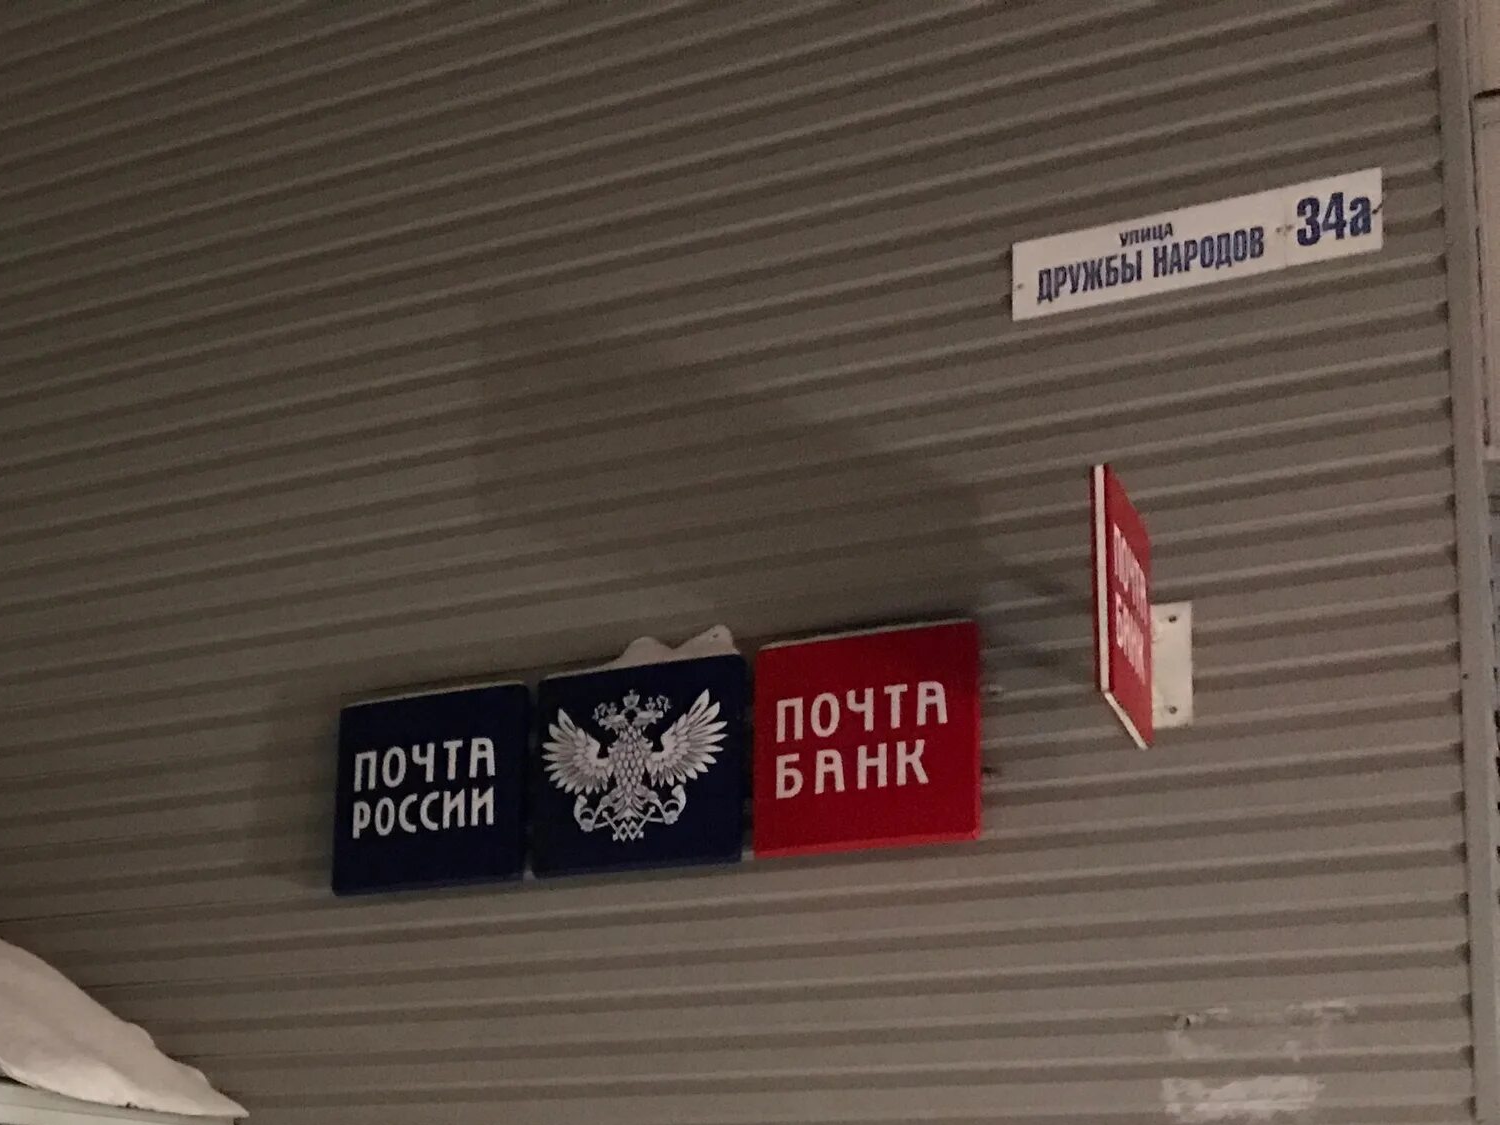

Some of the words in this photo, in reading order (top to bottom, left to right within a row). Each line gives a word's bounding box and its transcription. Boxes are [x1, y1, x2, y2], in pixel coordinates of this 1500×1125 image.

[1036, 251, 1142, 305] ДРУЖБЫ
[1152, 226, 1266, 278] НАРОДОВ
[1296, 192, 1373, 247] 34а
[1119, 222, 1174, 247] УЛИЦА
[775, 681, 949, 743] ПОЧТА
[353, 737, 496, 792] ПОЧТА
[775, 740, 929, 800] БАНК
[352, 787, 495, 839] РОССИИ
